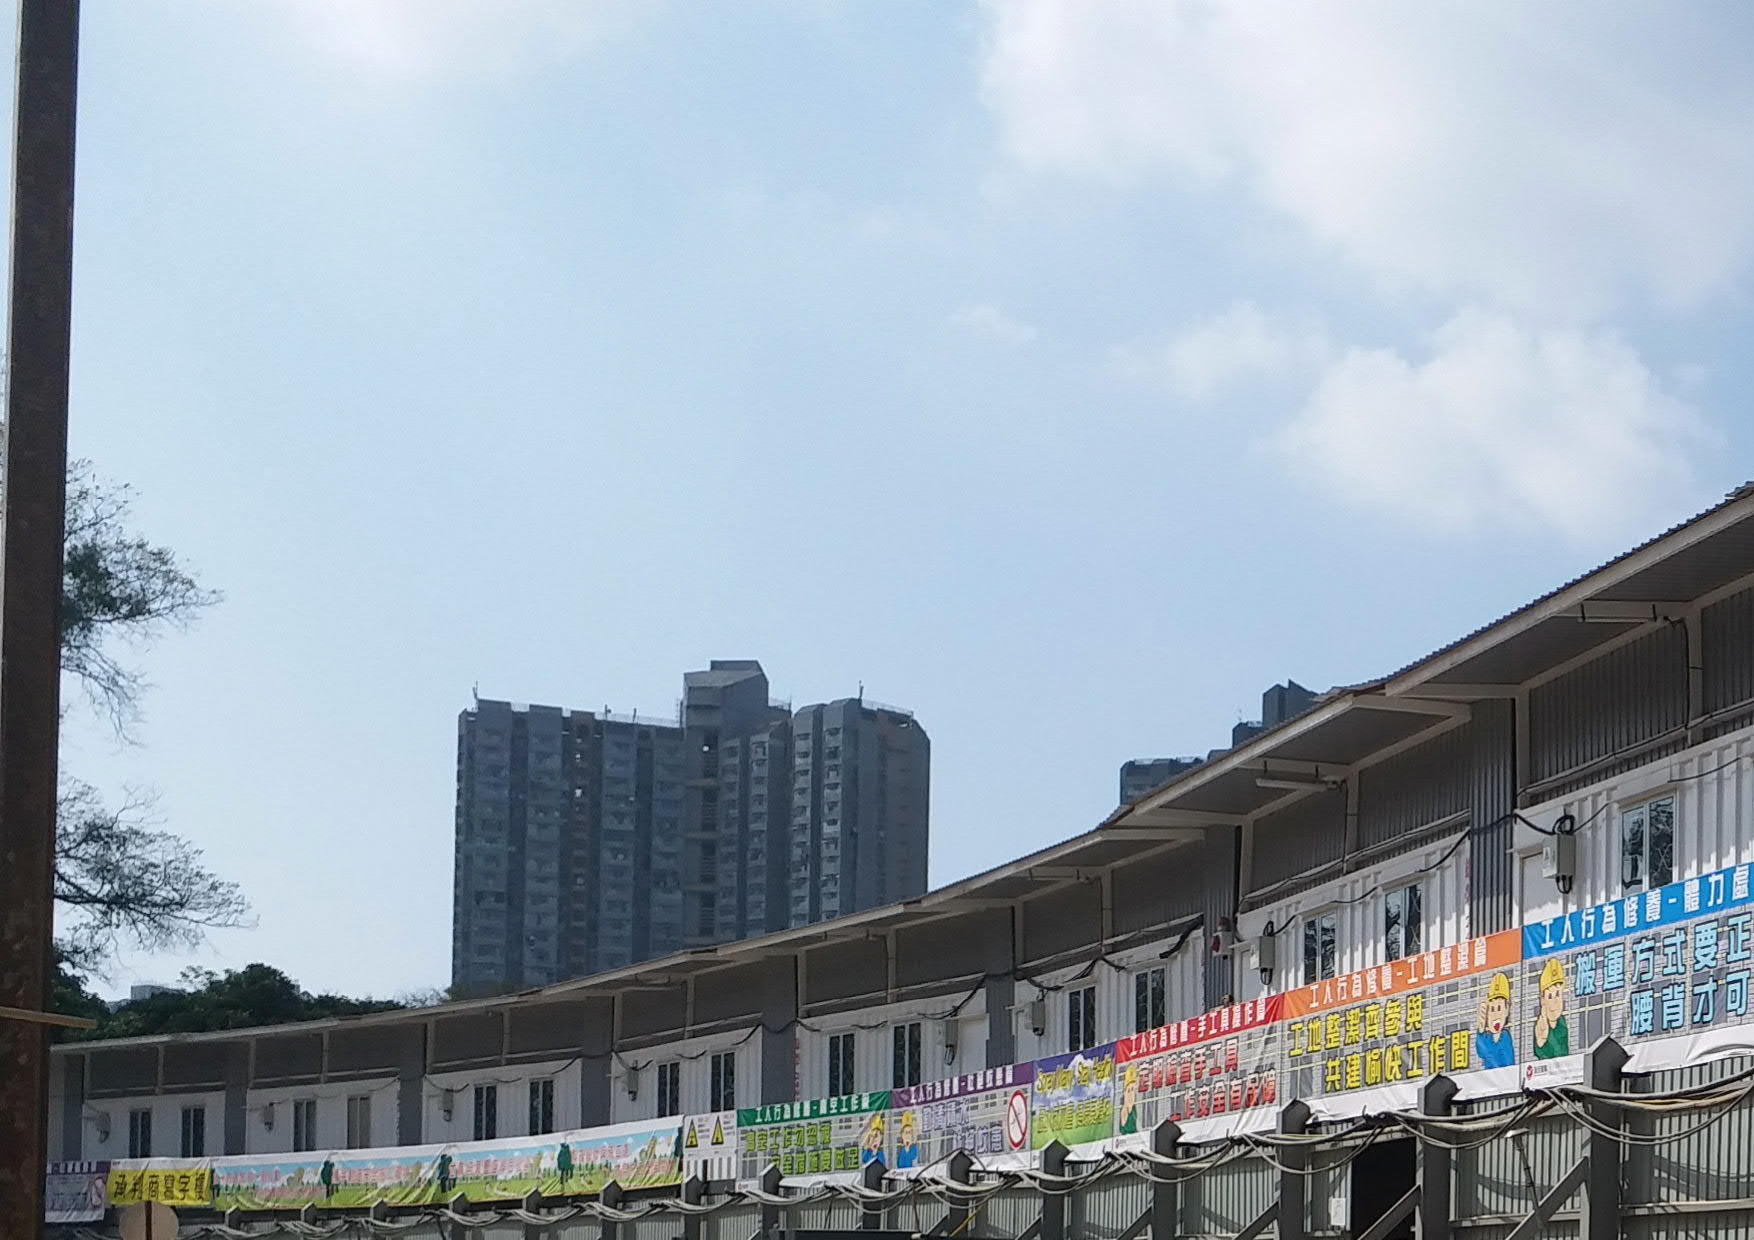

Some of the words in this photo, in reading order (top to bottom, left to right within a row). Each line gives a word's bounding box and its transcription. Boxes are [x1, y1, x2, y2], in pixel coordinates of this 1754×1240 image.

[1289, 995, 1424, 1057] 工地整潔齊參與
[1324, 1030, 1470, 1094] 共建愉快工作間
